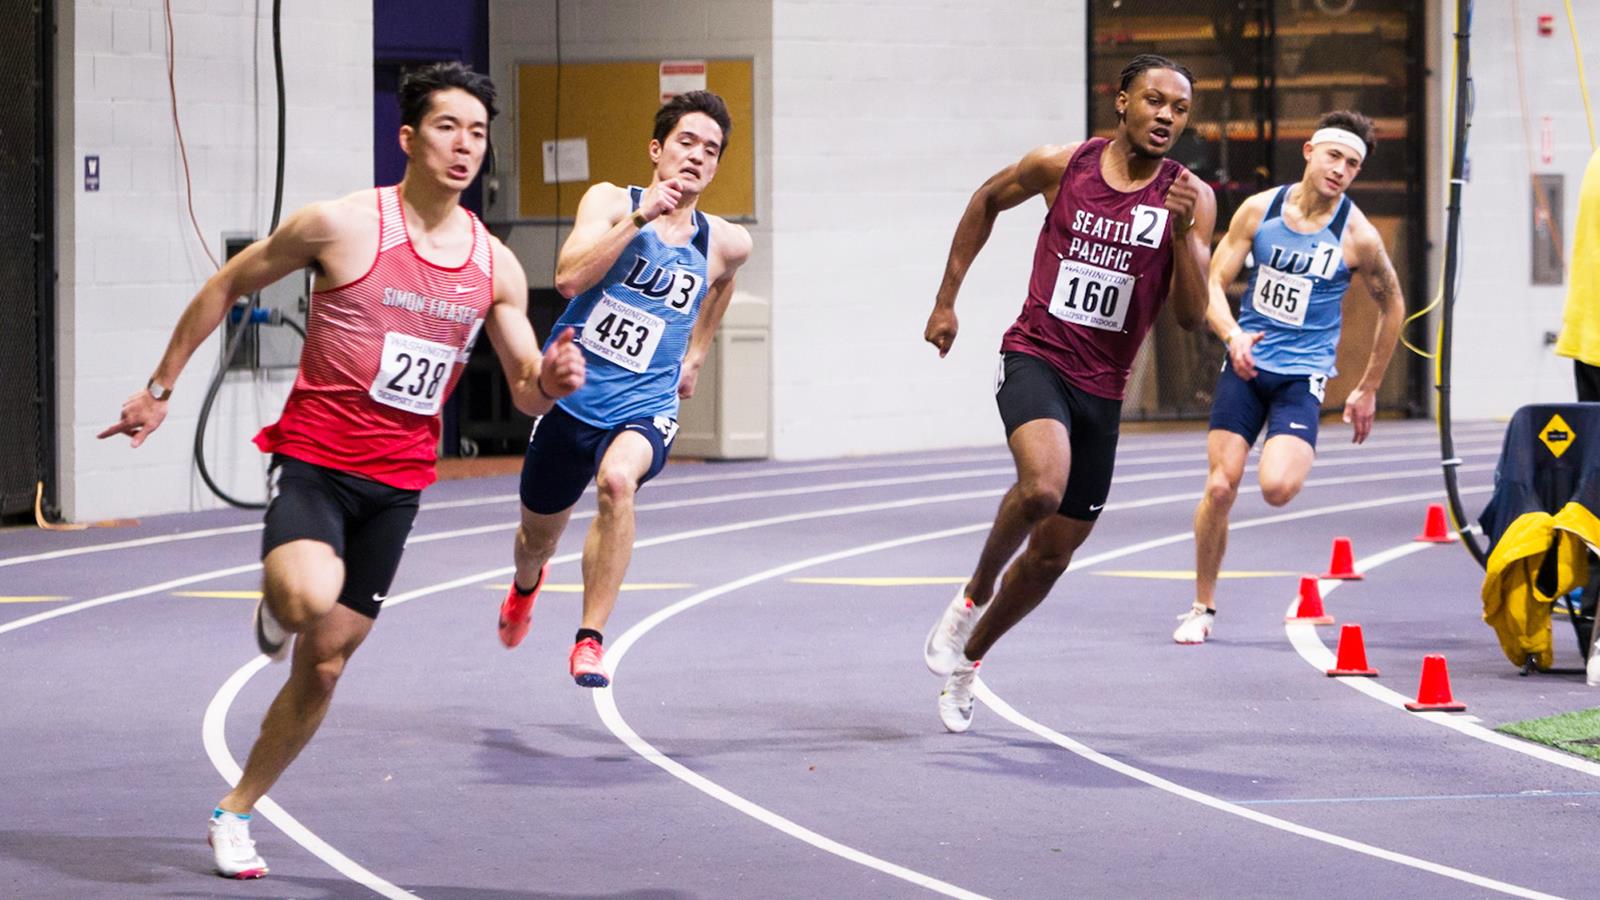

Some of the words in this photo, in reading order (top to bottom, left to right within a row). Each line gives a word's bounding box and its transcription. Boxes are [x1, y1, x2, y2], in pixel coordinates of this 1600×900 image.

[1072, 209, 1139, 247] SEATTL
[1136, 210, 1158, 245] 2
[1069, 237, 1133, 271] PACIFIC
[1322, 248, 1334, 275] 1
[383, 287, 425, 313] SIMON
[671, 274, 696, 309] 3
[1064, 277, 1119, 318] 160
[1260, 279, 1300, 313] 465
[595, 312, 649, 357] 453
[386, 353, 446, 399] 238
